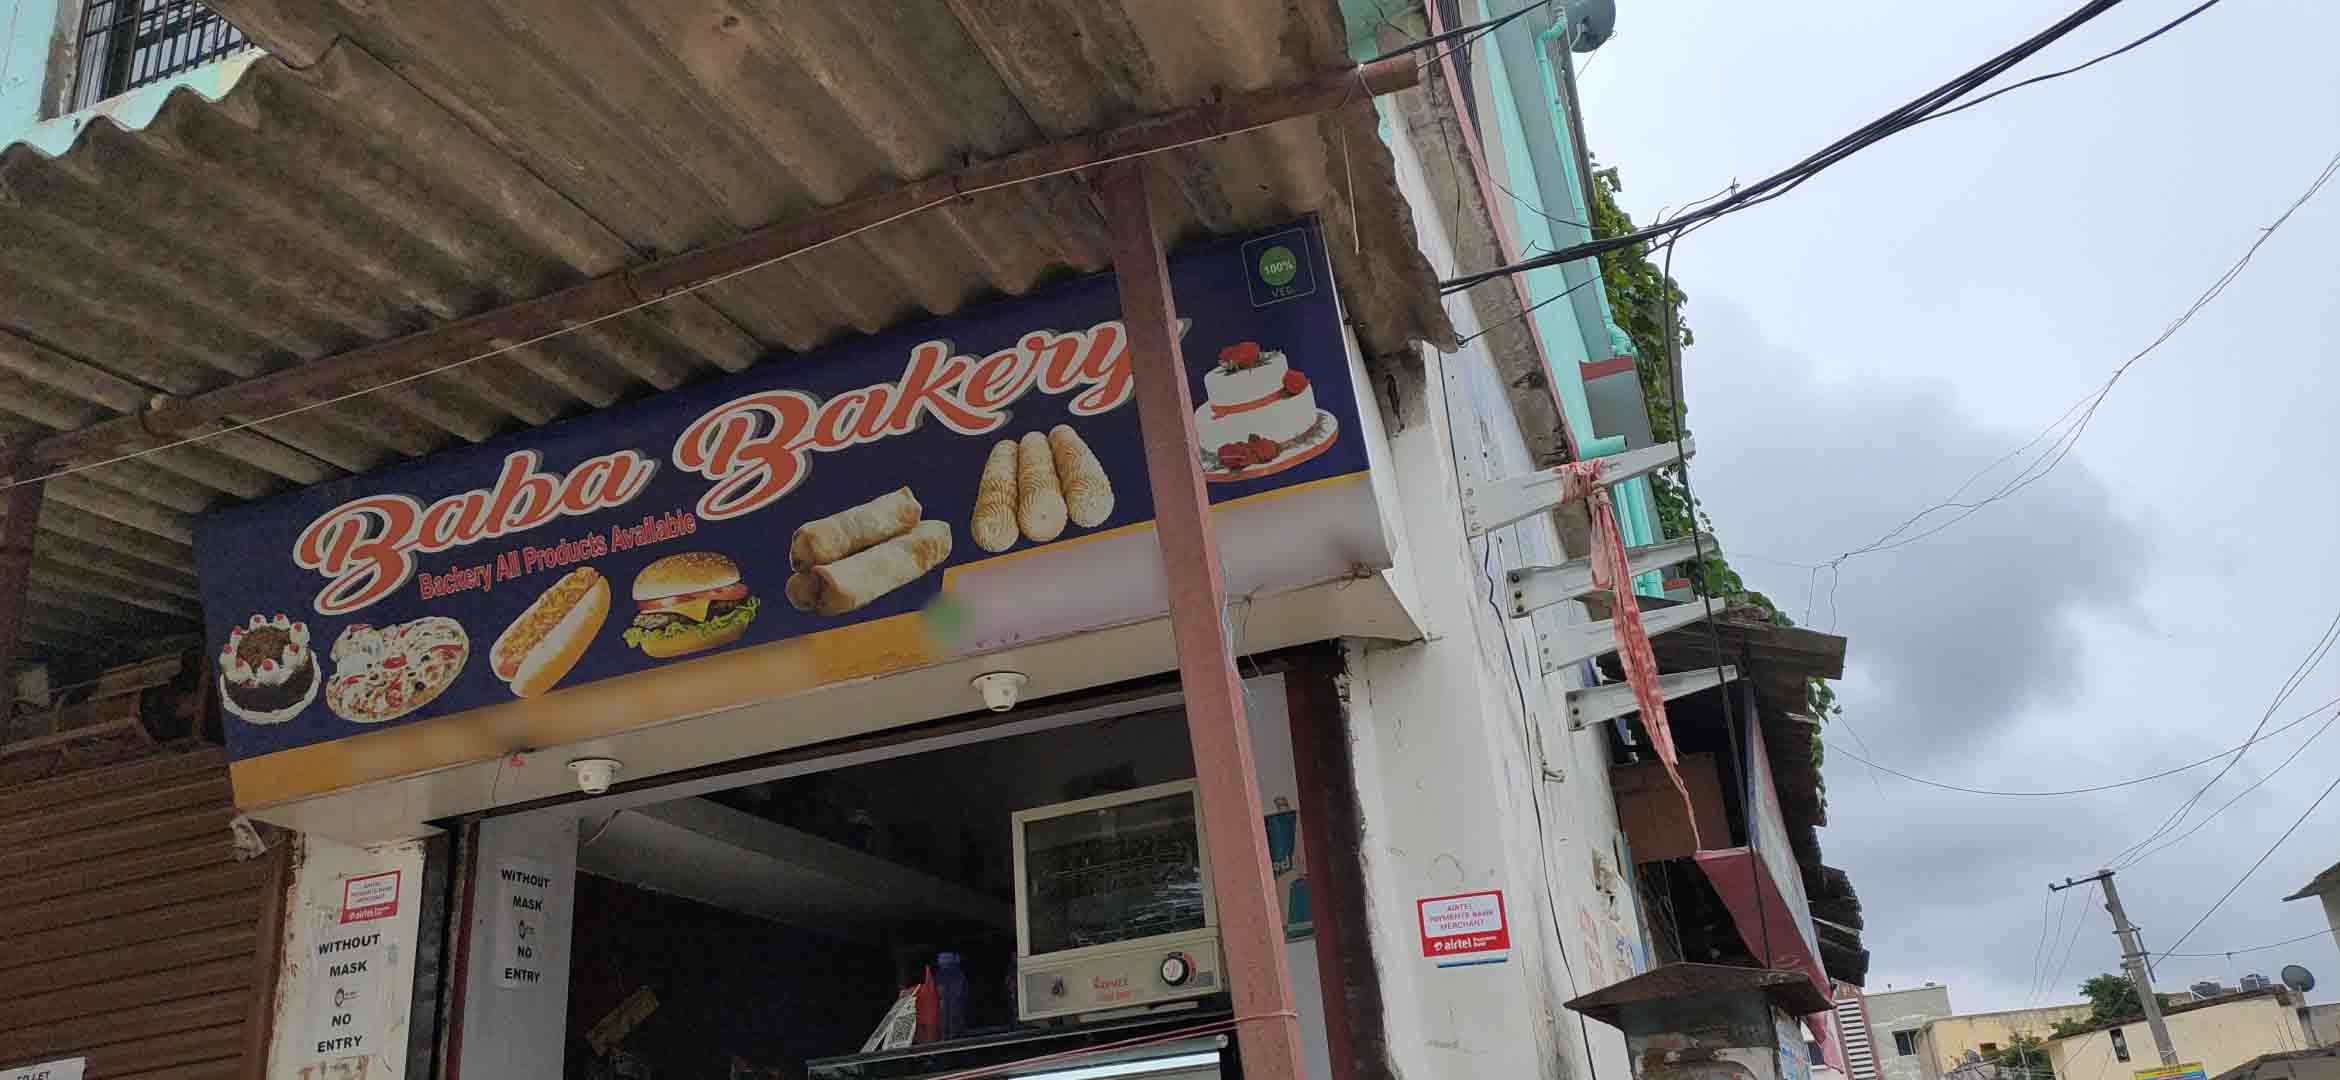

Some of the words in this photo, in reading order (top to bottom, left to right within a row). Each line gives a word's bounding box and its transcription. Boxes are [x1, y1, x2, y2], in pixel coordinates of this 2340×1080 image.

[1264, 258, 1294, 275] 100%
[293, 449, 656, 615] Baba
[672, 318, 1190, 520] Bakery
[418, 562, 493, 600] Backery
[496, 550, 521, 582] All
[523, 532, 609, 573] Products
[611, 508, 697, 552] Available
[500, 868, 551, 889] WITHOUT
[512, 895, 543, 912] MASK
[318, 933, 381, 955] WITHOUT
[517, 945, 533, 959] NO
[1443, 937, 1472, 951] airtel
[328, 959, 368, 978] MASK
[504, 967, 541, 984] ENTRY
[331, 1013, 352, 1027] NO
[316, 1035, 363, 1053] ENTRY
